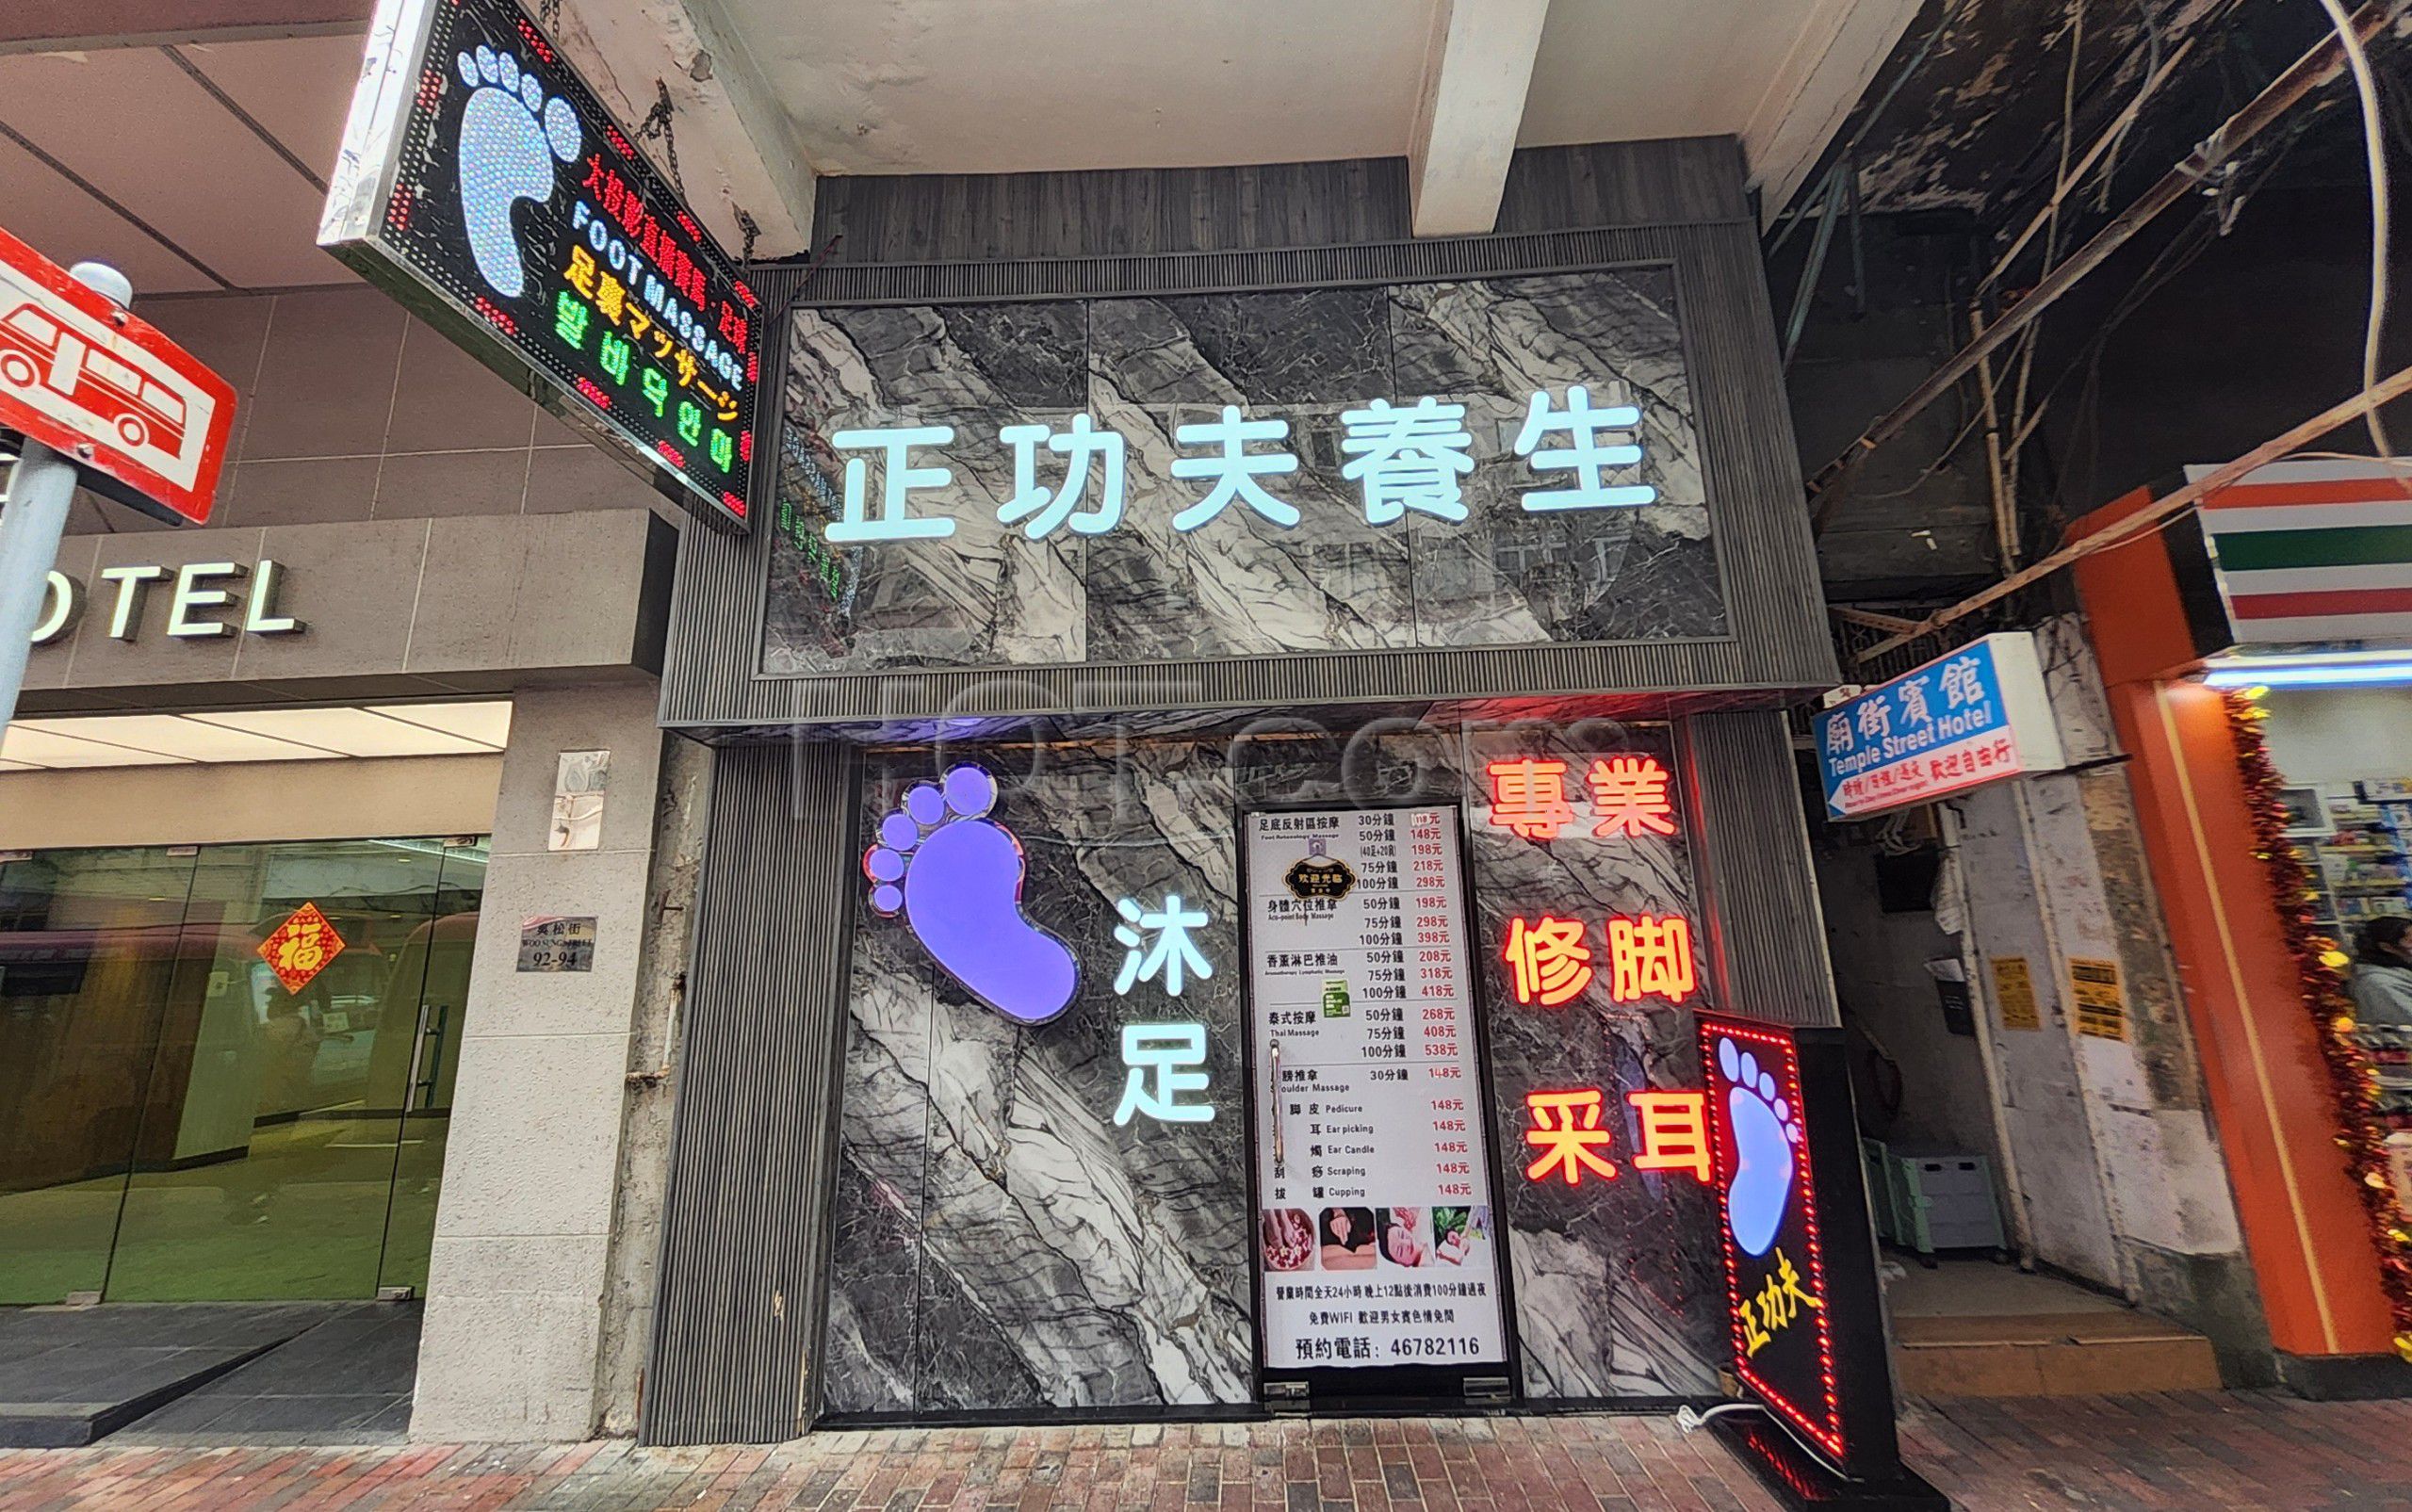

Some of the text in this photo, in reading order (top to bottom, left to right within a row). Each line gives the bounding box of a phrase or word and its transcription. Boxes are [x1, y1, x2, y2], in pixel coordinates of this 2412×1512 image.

[573, 200, 743, 392] FOOT MASSAGE
[563, 244, 739, 421] 足裏マッサージ
[824, 384, 1657, 545] 正功夫養生
[1826, 656, 1986, 756] 廟街賓館
[1829, 700, 1992, 777] Temple Street Hotel
[1487, 756, 1677, 839] 專業
[1259, 817, 1340, 831] 足底反射區按摩
[1359, 813, 1394, 826] 30分鐘
[1359, 829, 1442, 842] 50分鐘 148元
[1411, 844, 1442, 855] 198元
[1361, 860, 1443, 873] 75分鐘 218元
[1357, 876, 1445, 889] 100分鐘 298元
[1363, 897, 1400, 910] 50分鐘
[1416, 897, 1447, 908] 198元
[1364, 916, 1448, 929] 75分鐘 298元
[278, 922, 323, 971] 福
[1360, 932, 1449, 946] 100分鐘 398元
[533, 951, 578, 967] 92-94
[1366, 951, 1404, 963] 50分鐘
[1419, 951, 1451, 963] 208元
[1506, 917, 1697, 1007] 修脚
[1368, 967, 1452, 982] 75分鐘 318元
[1362, 985, 1454, 1000] 100分鐘 418元
[1113, 895, 1215, 1127] 沐足
[1269, 1008, 1455, 1025] 泰式按摩 50分鐘 268元
[1287, 1029, 1319, 1037] Massage
[1367, 1026, 1456, 1040] 75分鐘 408元
[1361, 1044, 1458, 1058] 100分鐘 538元
[1272, 1067, 1460, 1081] 膀推拿 30分鐘 148元
[1312, 1084, 1349, 1093] Massage
[1326, 1105, 1362, 1114] Pedicure
[1431, 1098, 1464, 1112] 148元
[1327, 1125, 1340, 1133] Ear
[1343, 1124, 1374, 1134] picking
[1433, 1120, 1466, 1132] 148元
[1524, 1089, 1712, 1185] 采耳
[1328, 1146, 1341, 1154] Ear
[1435, 1141, 1468, 1154] 148元
[1328, 1167, 1365, 1177] Scraping
[1437, 1162, 1470, 1175] 148元
[1329, 1188, 1364, 1197] Cupping
[1438, 1183, 1472, 1195] 148元
[1310, 1311, 1352, 1325] 免費WIFI
[1391, 1337, 1479, 1357] 46782116
